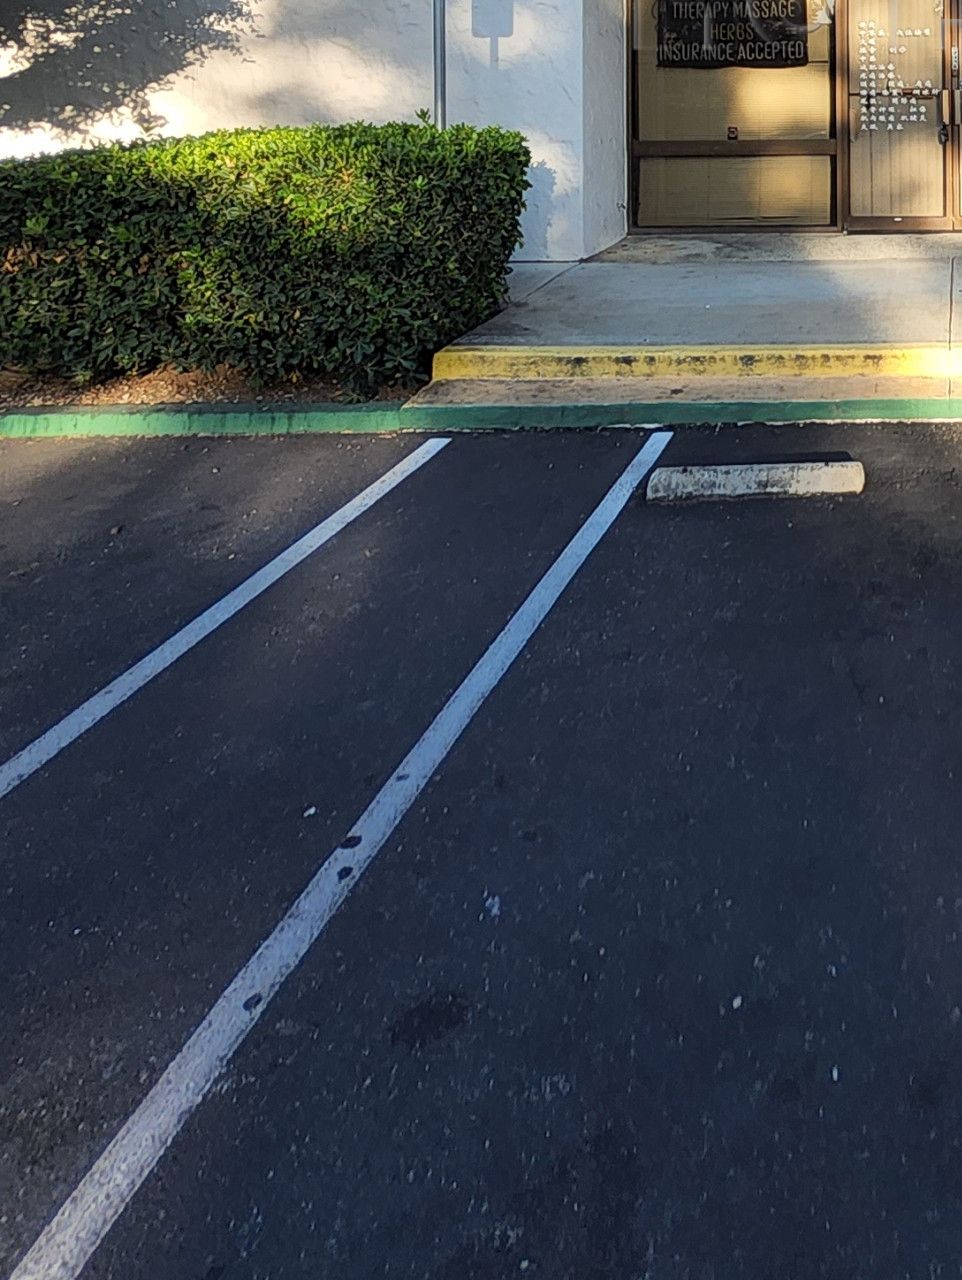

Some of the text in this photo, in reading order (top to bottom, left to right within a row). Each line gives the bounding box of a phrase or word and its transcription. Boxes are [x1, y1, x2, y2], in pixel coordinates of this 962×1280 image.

[672, 0, 796, 19] THERAPY MASSAGE
[710, 23, 754, 41] HERBS
[659, 40, 804, 61] INSURANCE ACCEPTED
